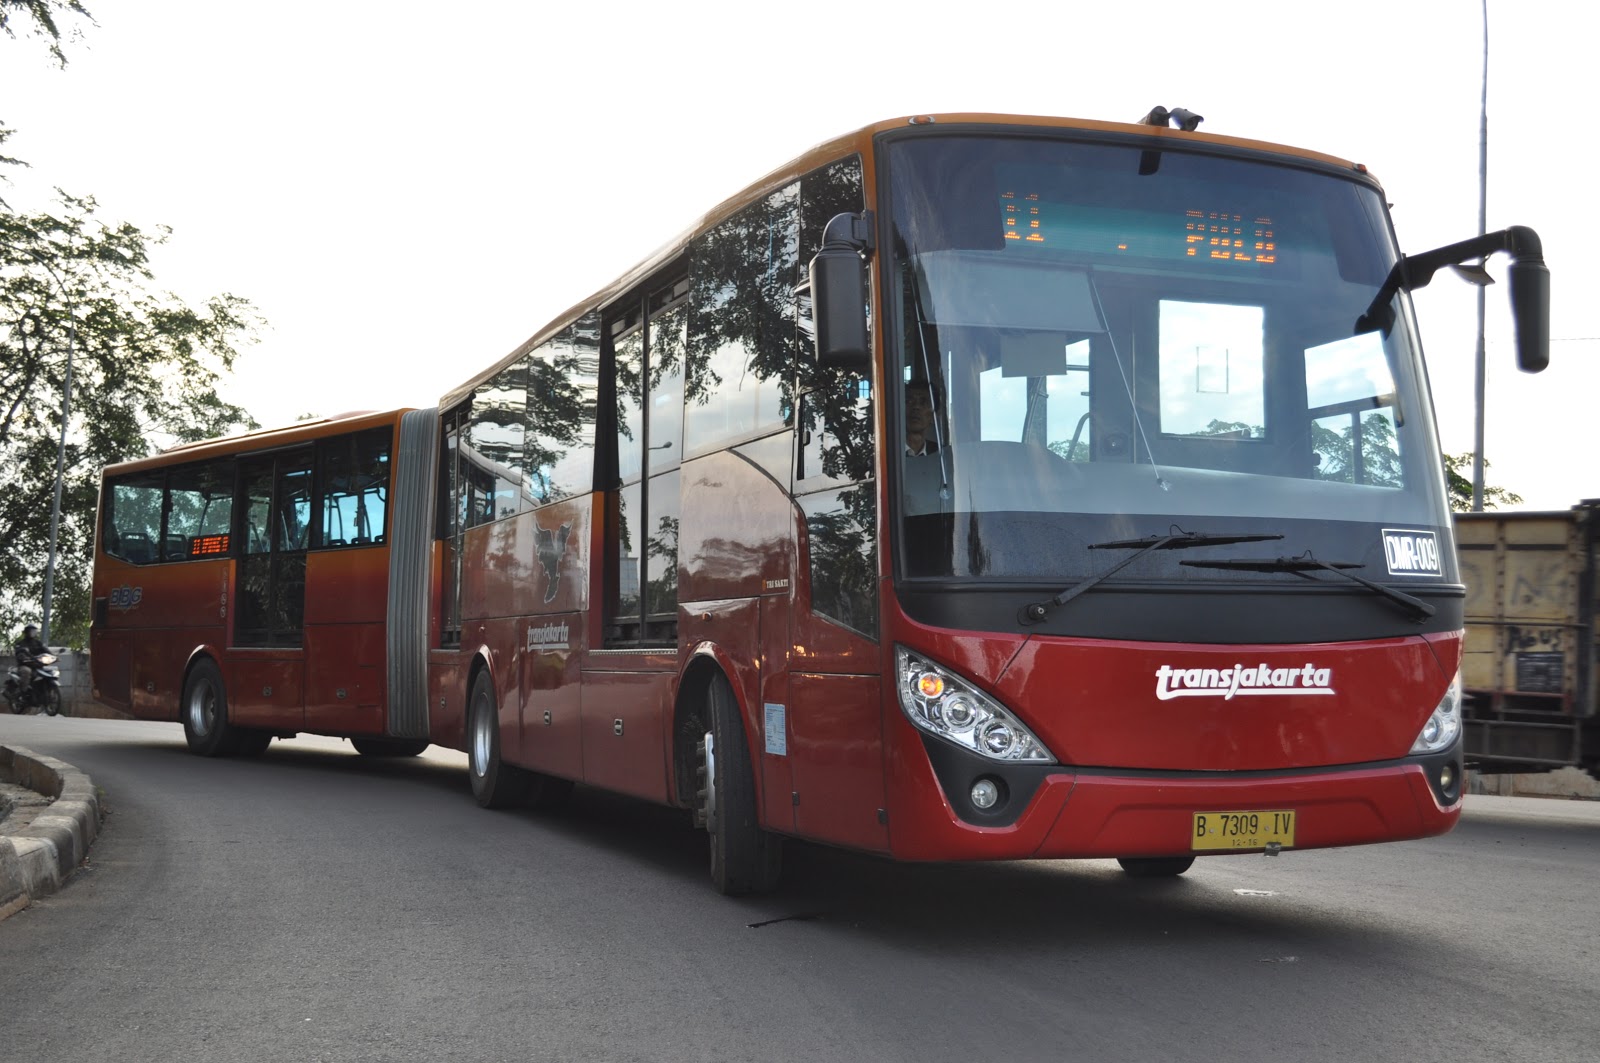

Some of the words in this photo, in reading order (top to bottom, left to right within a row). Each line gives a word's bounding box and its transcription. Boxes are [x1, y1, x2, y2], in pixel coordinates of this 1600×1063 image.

[1186, 210, 1275, 263] PULO
[1385, 535, 1438, 571] DMR-009
[109, 586, 143, 606] BBG
[527, 621, 570, 653] transjakarta
[1155, 663, 1335, 700] transjakarta
[1196, 815, 1207, 837] B
[1220, 814, 1259, 837] 7309
[1273, 813, 1291, 835] IV
